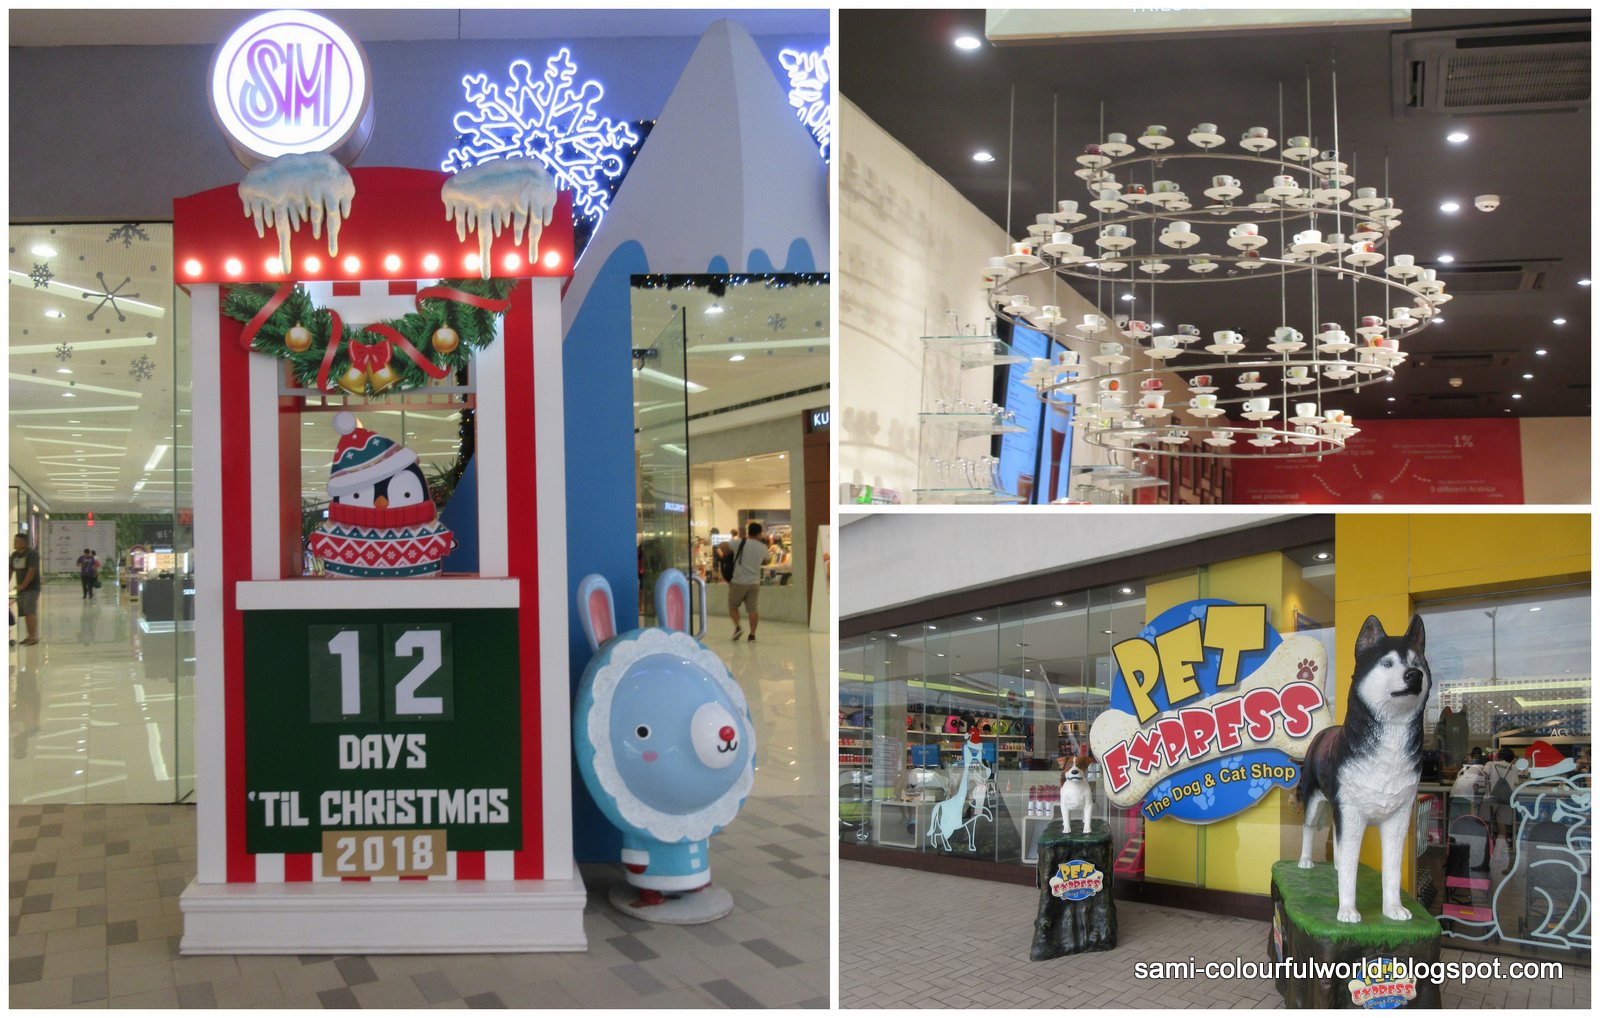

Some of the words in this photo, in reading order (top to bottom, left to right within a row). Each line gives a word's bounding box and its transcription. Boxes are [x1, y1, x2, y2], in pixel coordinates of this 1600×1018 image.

[239, 39, 333, 128] SM
[1454, 434, 1474, 448] 1%
[1112, 604, 1267, 724] PET
[339, 733, 427, 770] DAYS
[1102, 681, 1324, 793] EXPRESS
[1145, 795, 1171, 818] The
[1172, 783, 1201, 802] Dog
[1203, 773, 1216, 788] &
[1219, 766, 1247, 783] Cat
[1251, 763, 1296, 782] Shop
[336, 835, 433, 872] 2018
[1059, 863, 1095, 881] PET
[1053, 879, 1101, 893] EXPRESS
[1353, 983, 1414, 1000] EXPRESS
